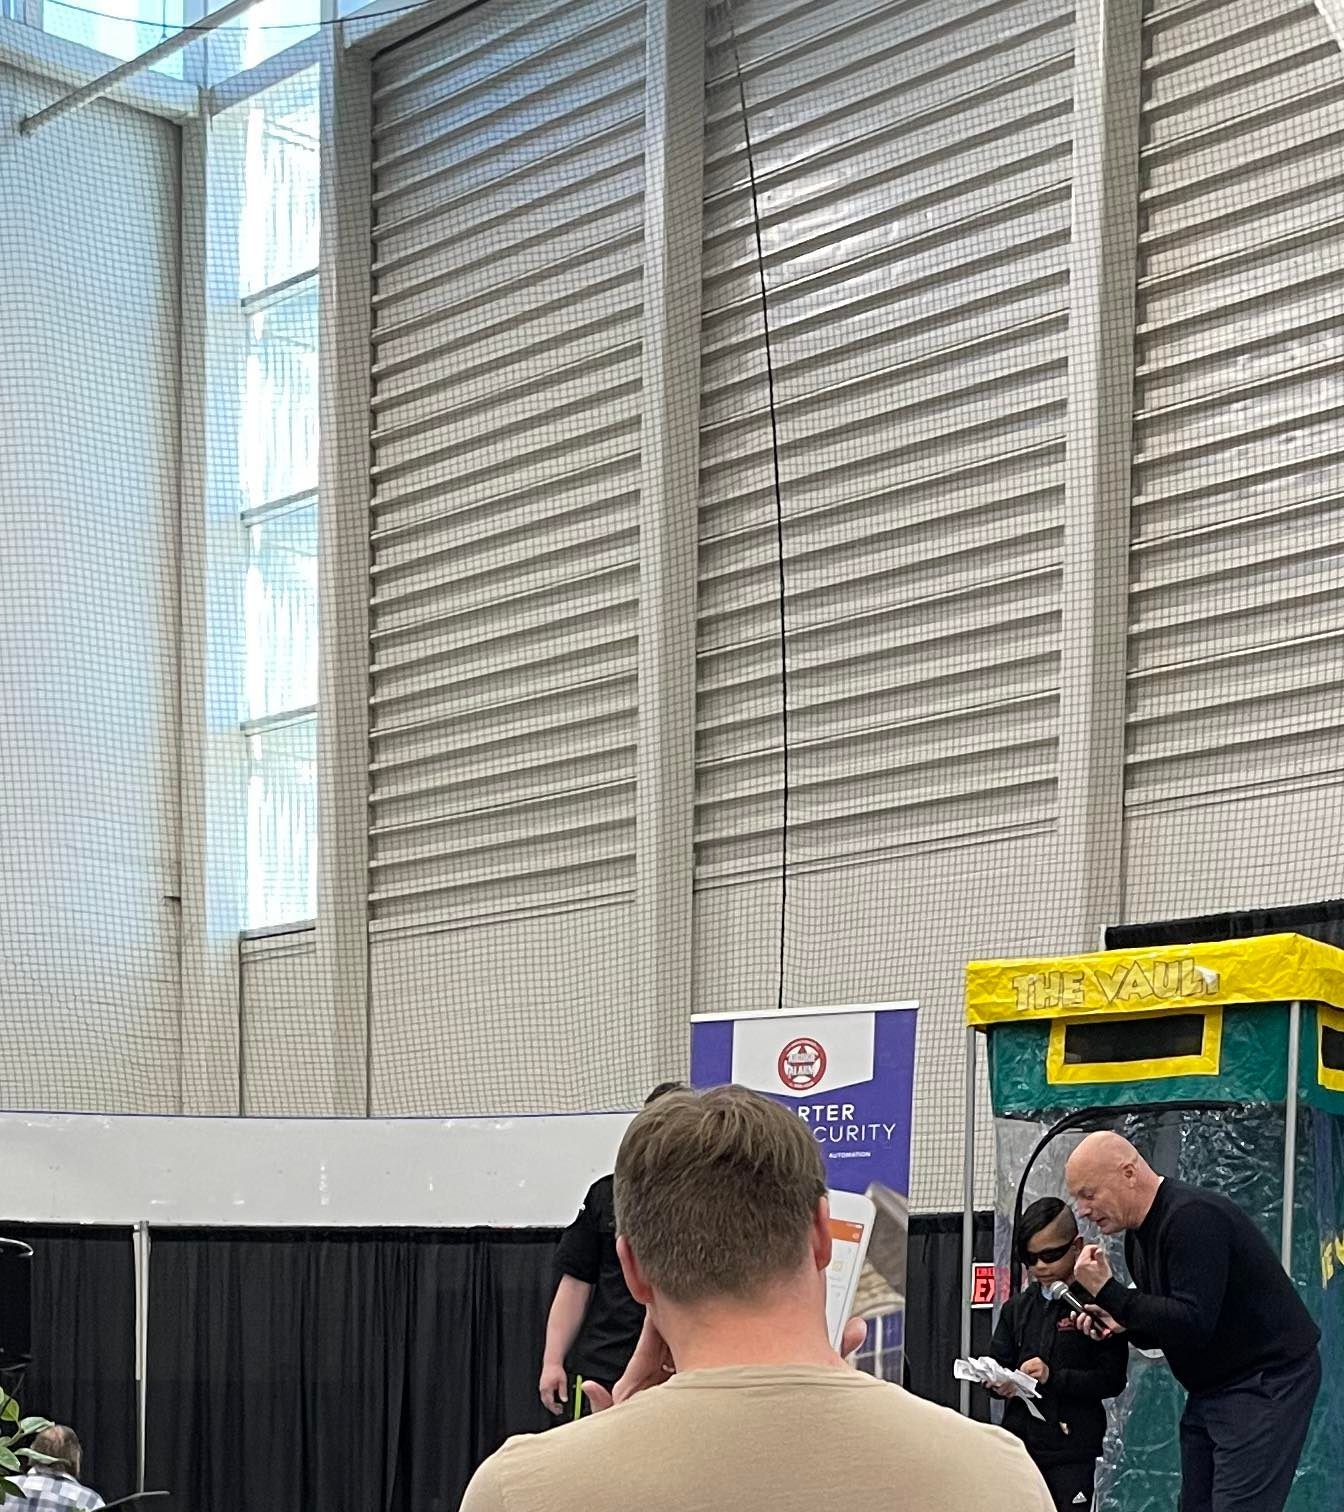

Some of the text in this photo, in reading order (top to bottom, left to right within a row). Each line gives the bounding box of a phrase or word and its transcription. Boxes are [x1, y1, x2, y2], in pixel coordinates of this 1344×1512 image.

[1012, 969, 1085, 1011] THE
[788, 1103, 855, 1122] RTER
[812, 1123, 896, 1143] CURITY
